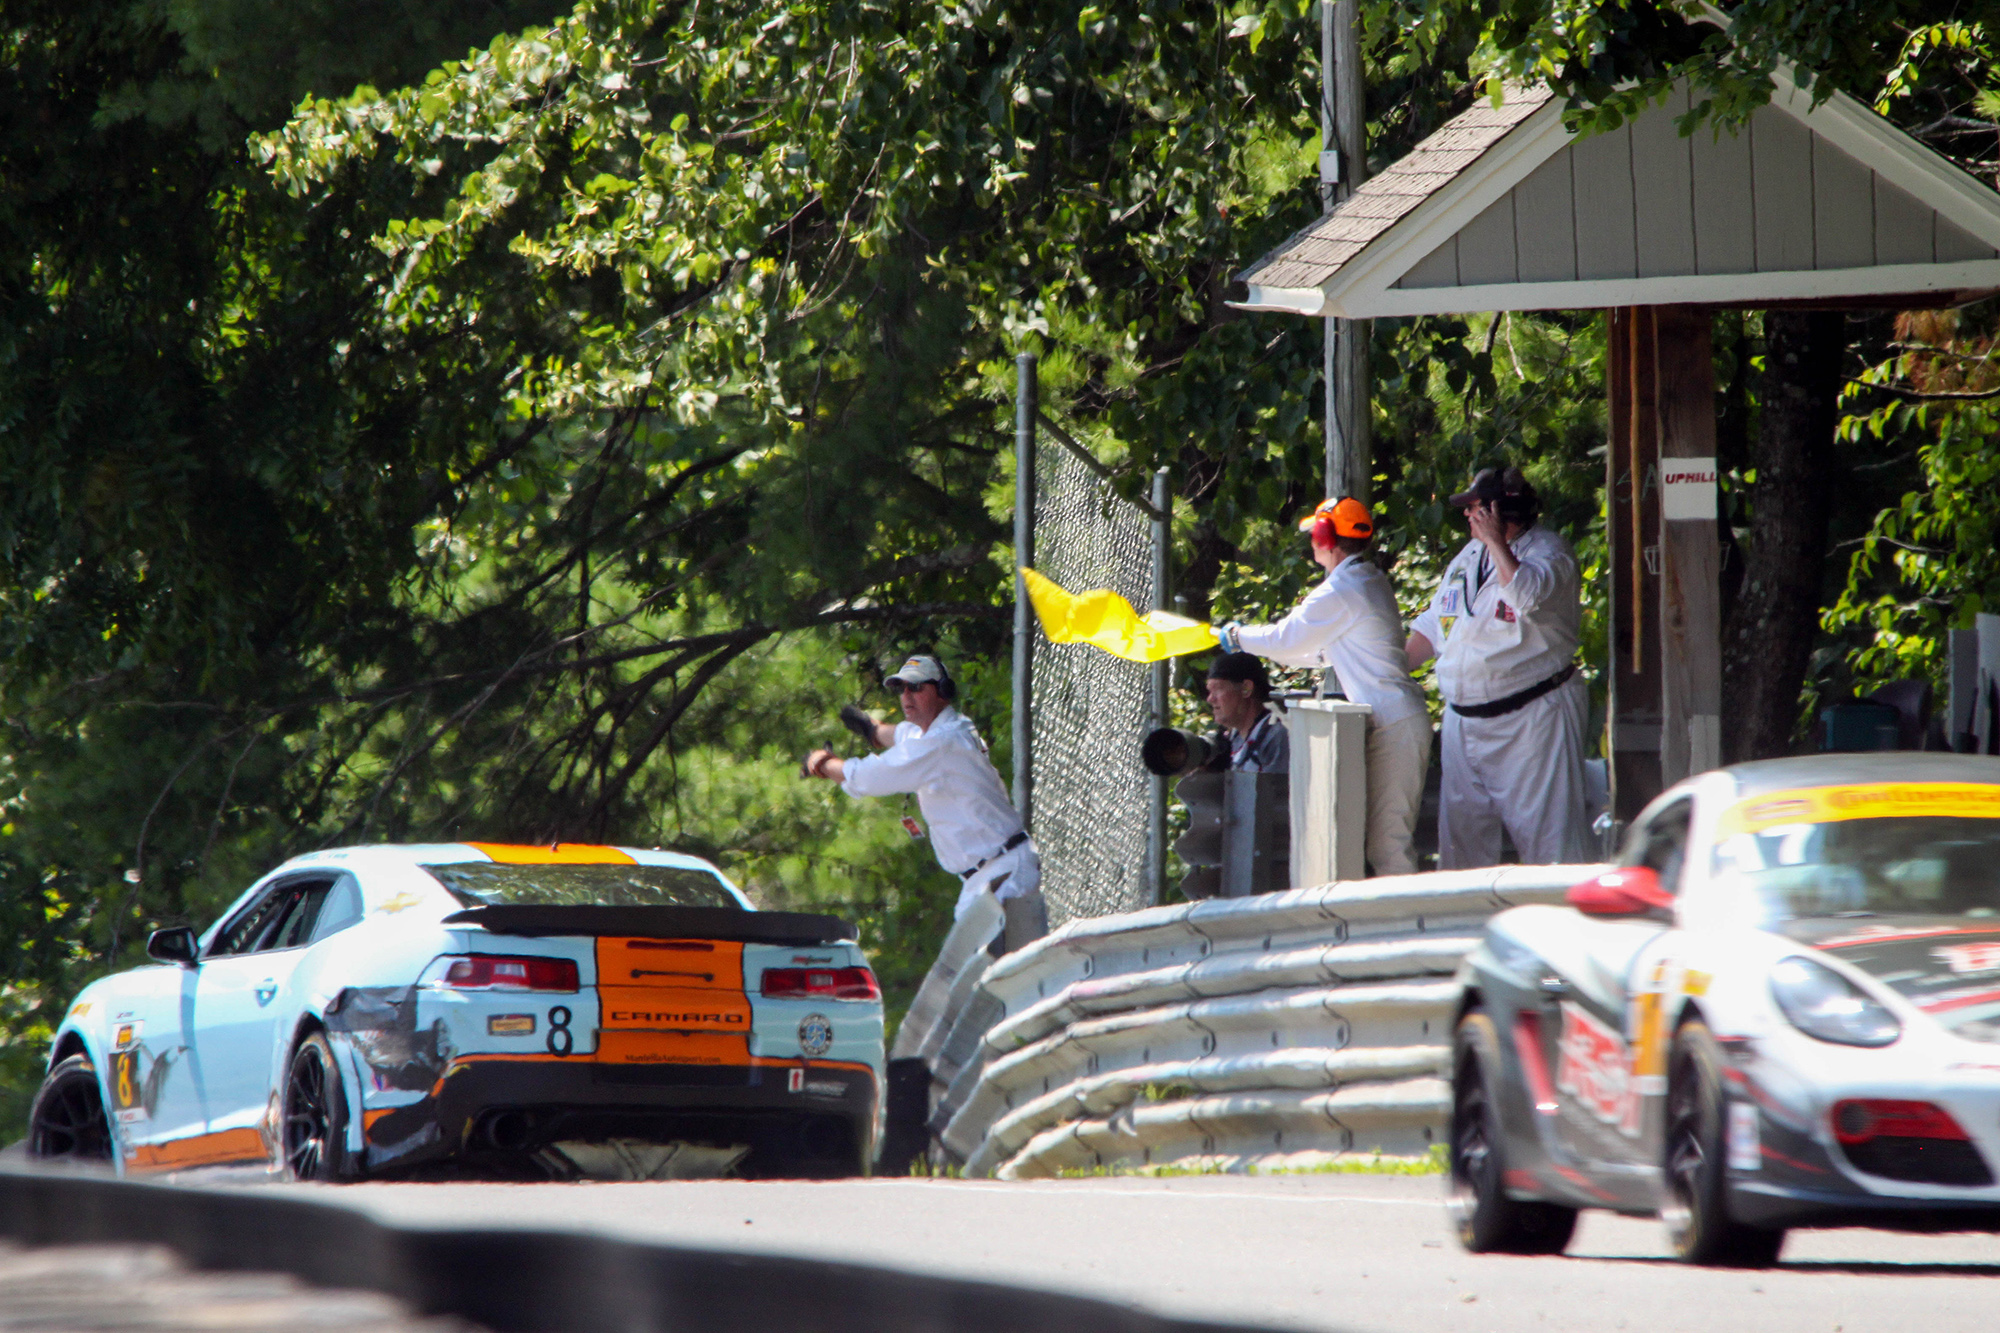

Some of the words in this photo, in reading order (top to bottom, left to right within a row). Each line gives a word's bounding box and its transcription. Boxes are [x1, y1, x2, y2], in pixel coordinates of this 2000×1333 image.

[1665, 472, 1717, 484] UPHILL
[546, 1005, 573, 1058] 8
[611, 1011, 744, 1024] CAMARO
[117, 1053, 133, 1108] 8
